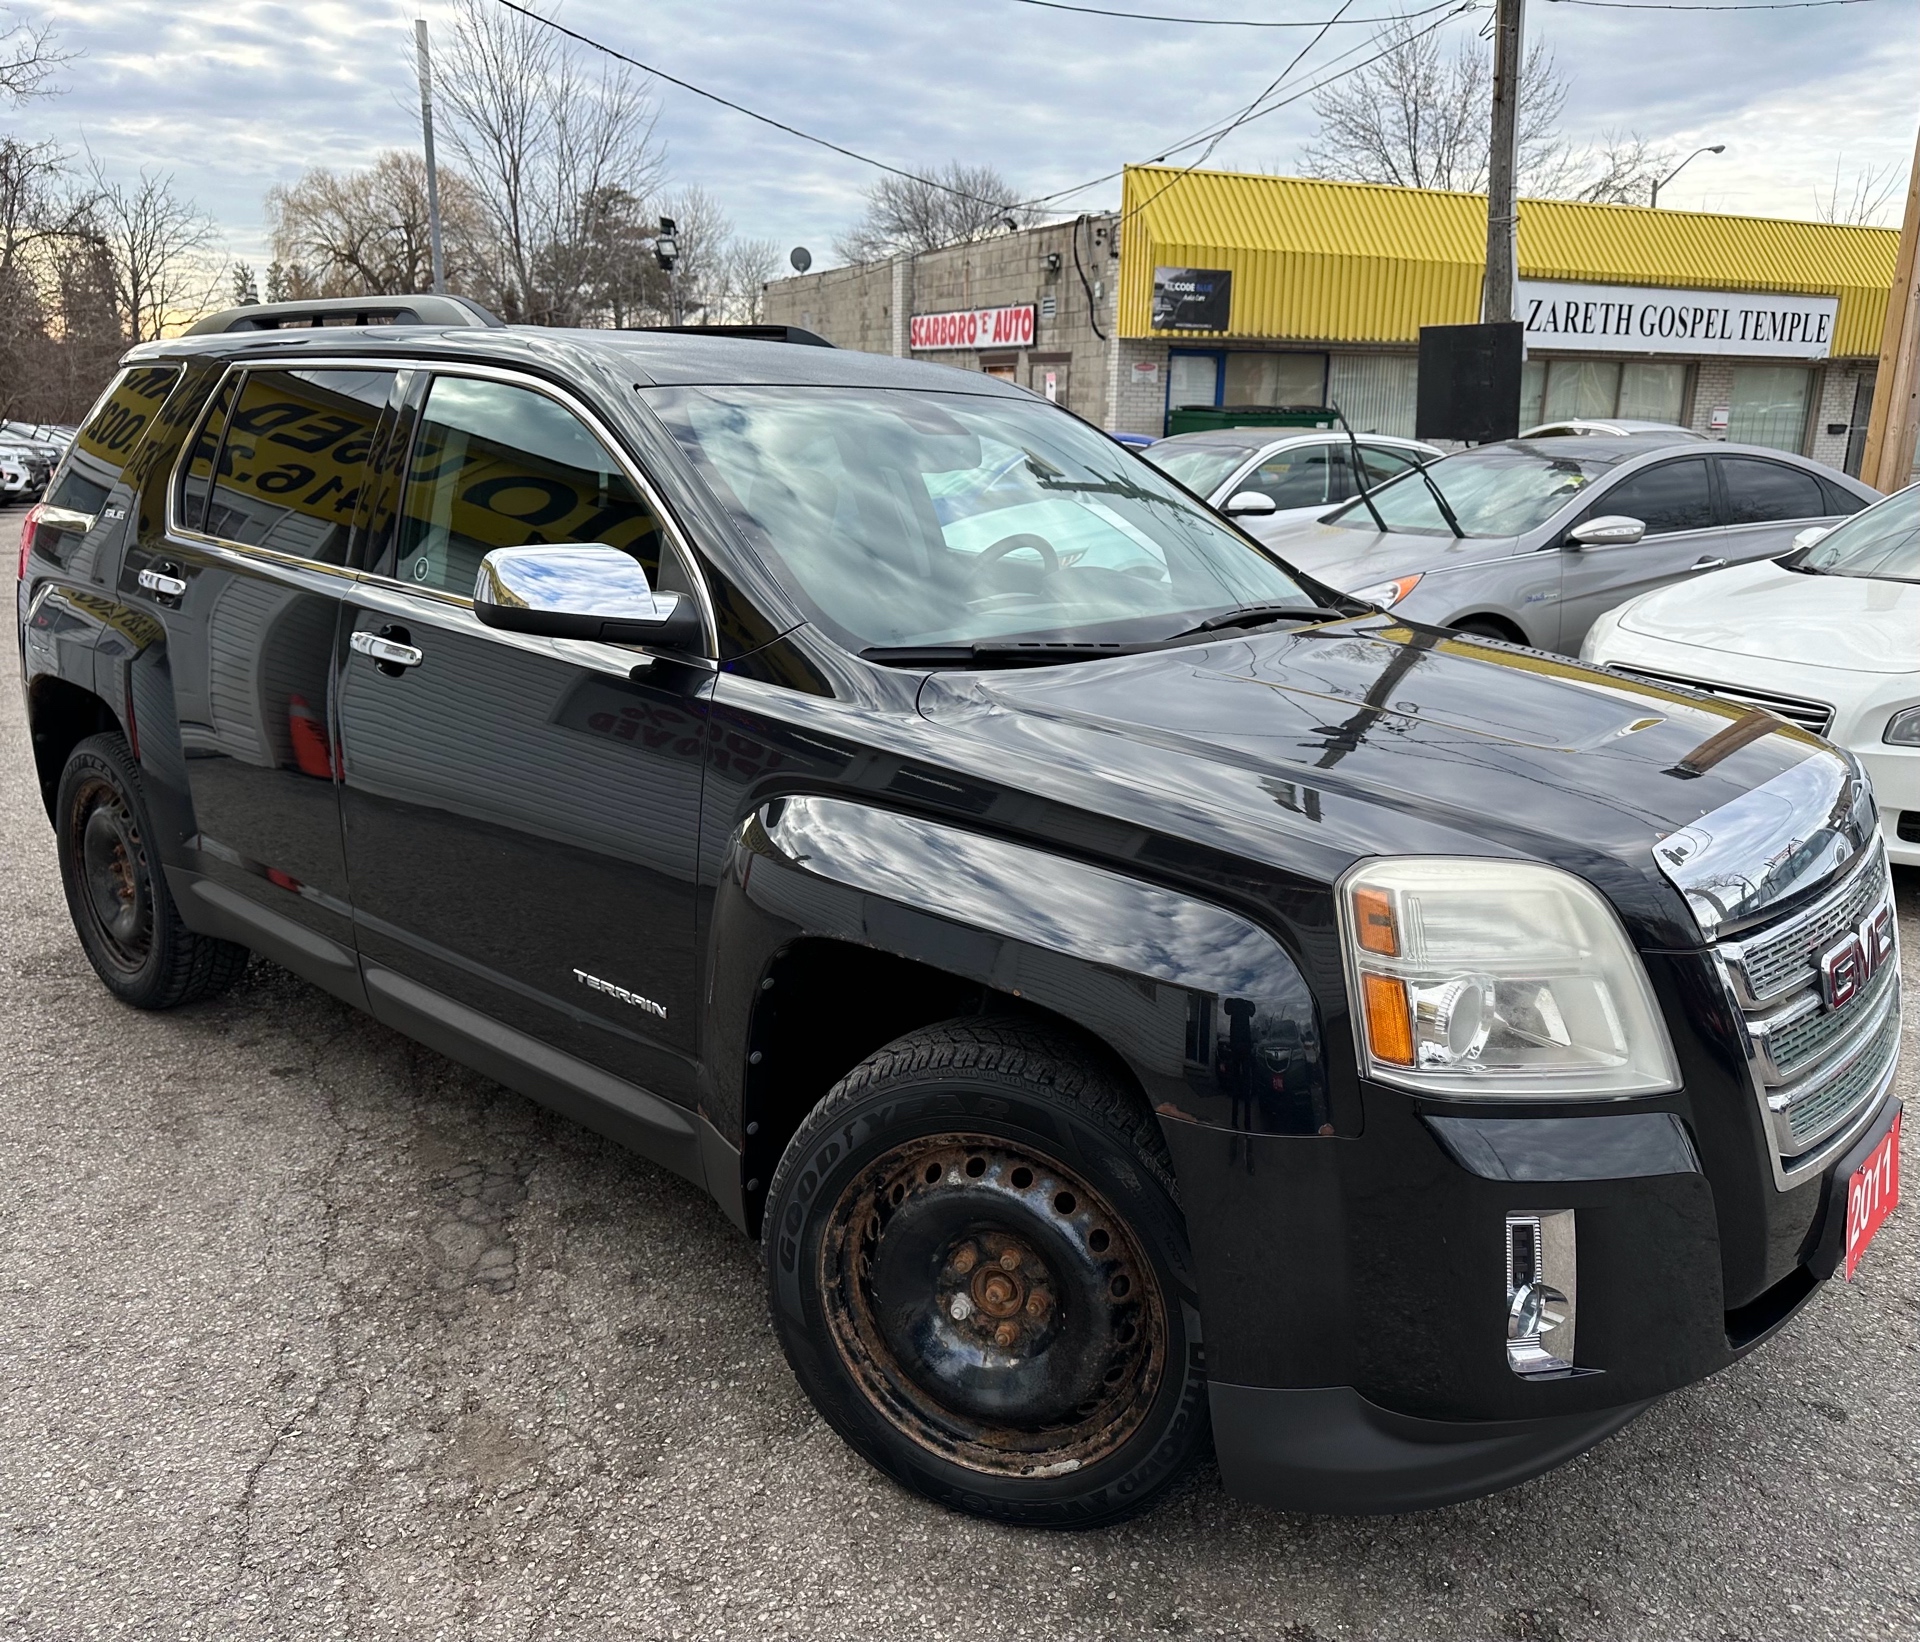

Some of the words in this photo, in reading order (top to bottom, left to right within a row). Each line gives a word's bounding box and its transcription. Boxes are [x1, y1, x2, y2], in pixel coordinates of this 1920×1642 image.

[911, 313, 977, 347] SCARBORO
[993, 308, 1032, 343] AUTO
[1525, 299, 1634, 335] ZARETH
[1640, 304, 1733, 341] GOSPEL
[1739, 310, 1831, 343] TEMPLE
[573, 968, 667, 1019] TERRAIN
[1821, 900, 1892, 1010] GMC
[779, 1094, 1010, 1274] GOODYEAR
[1850, 1138, 1892, 1251] 2011
